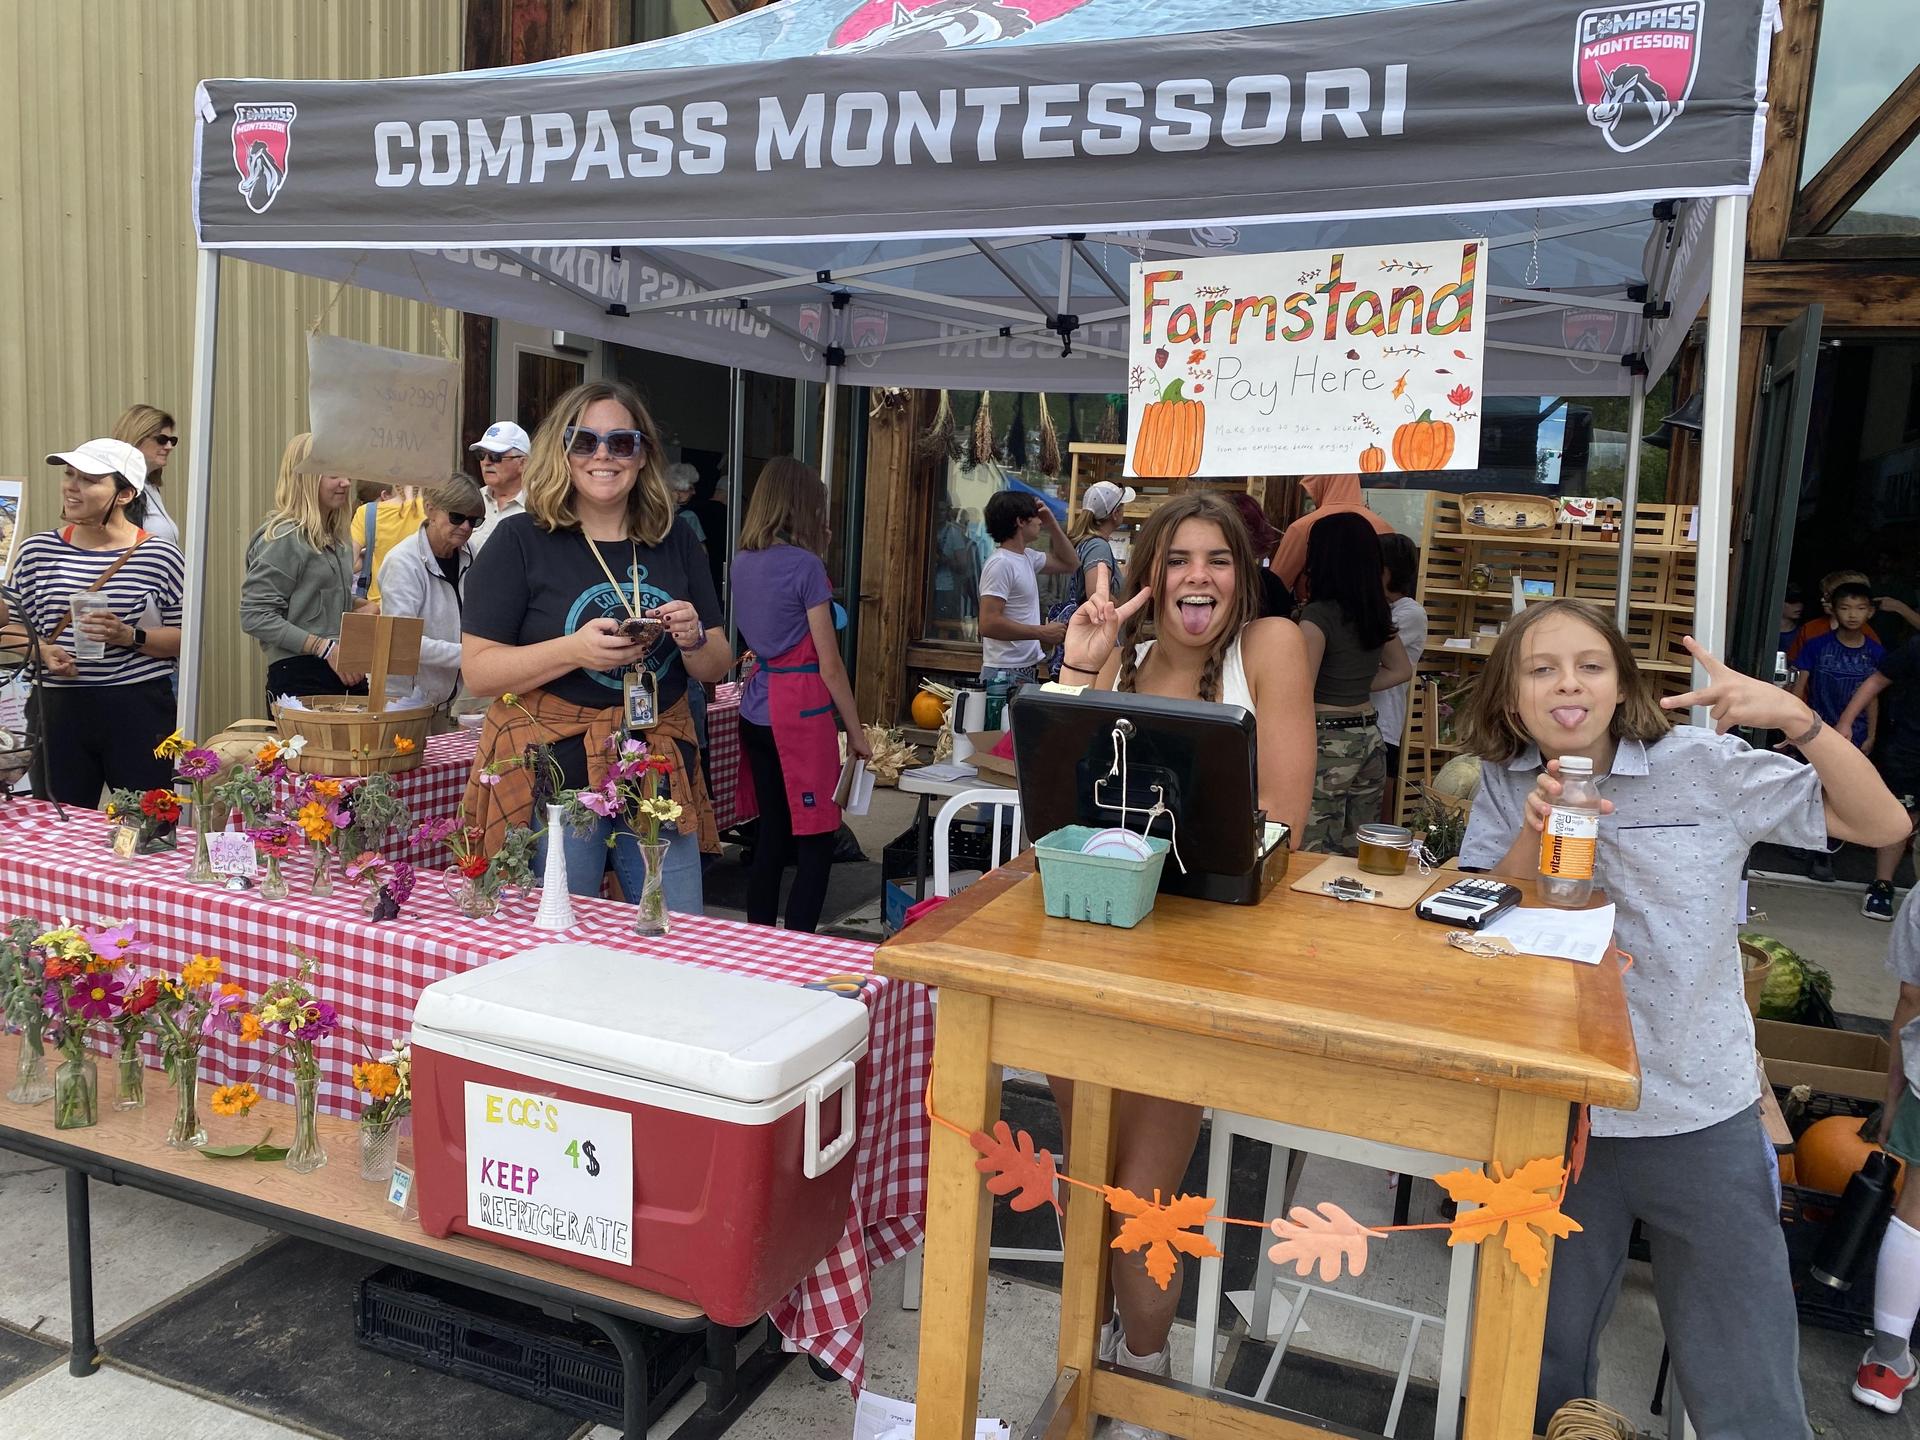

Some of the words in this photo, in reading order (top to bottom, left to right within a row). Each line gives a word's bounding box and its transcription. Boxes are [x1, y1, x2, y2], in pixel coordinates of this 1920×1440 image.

[1584, 34, 1689, 60] MONTESSORI
[374, 101, 728, 187] COMPASS
[755, 63, 1408, 172] MONTESSORI
[1143, 243, 1478, 345] Farmstand
[1214, 356, 1279, 415] Pay
[1291, 355, 1385, 397] Here
[480, 1156, 540, 1195] KEEP
[479, 1192, 629, 1258] REFRIGERATE
